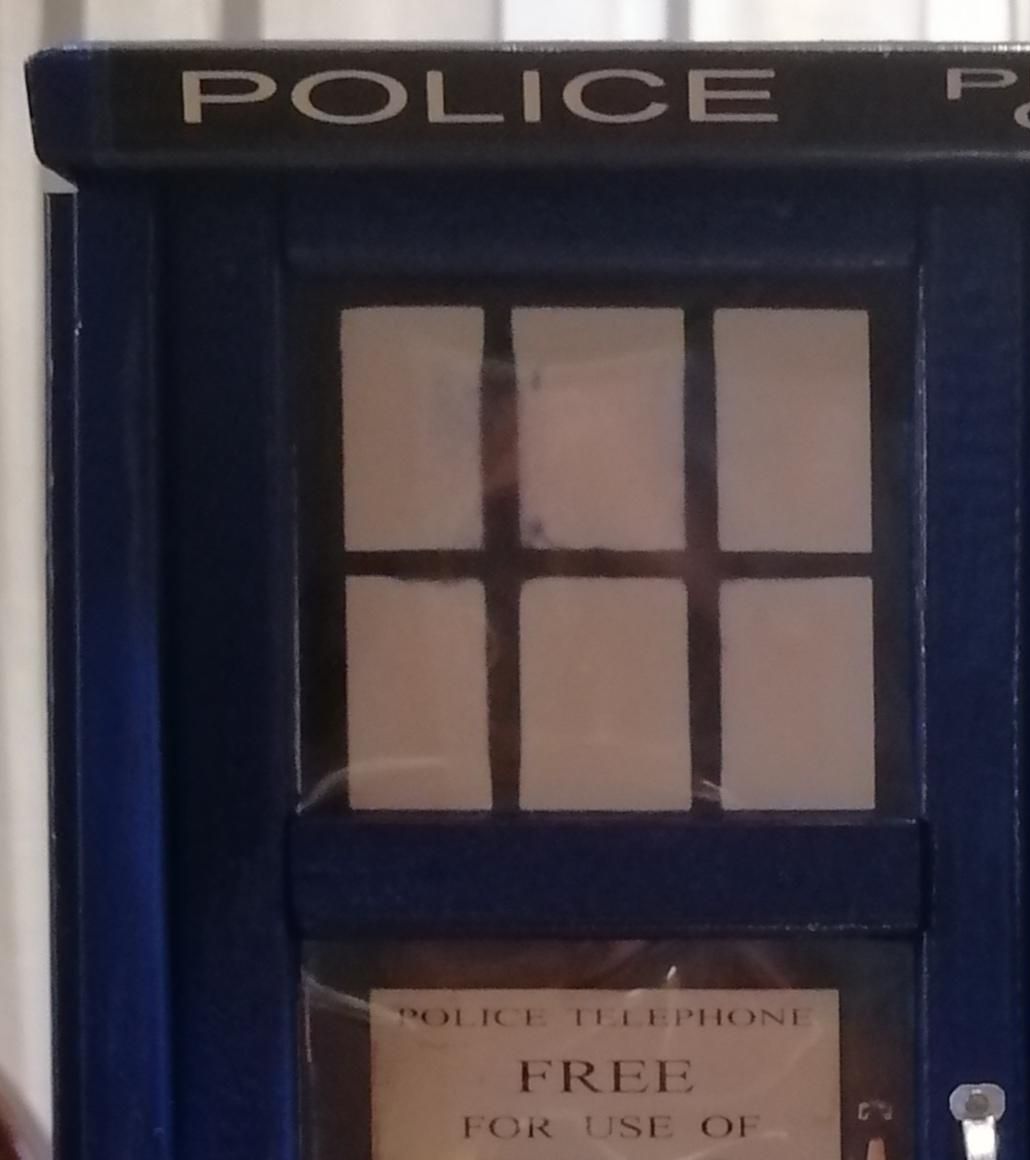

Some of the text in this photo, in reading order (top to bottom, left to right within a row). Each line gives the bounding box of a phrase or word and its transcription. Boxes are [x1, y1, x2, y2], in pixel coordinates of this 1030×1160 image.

[180, 68, 778, 124] POLICE
[400, 1007, 815, 1027] POLICE TELEPHONE
[519, 1059, 694, 1094] FREE
[463, 1115, 761, 1138] FOR USE OF
